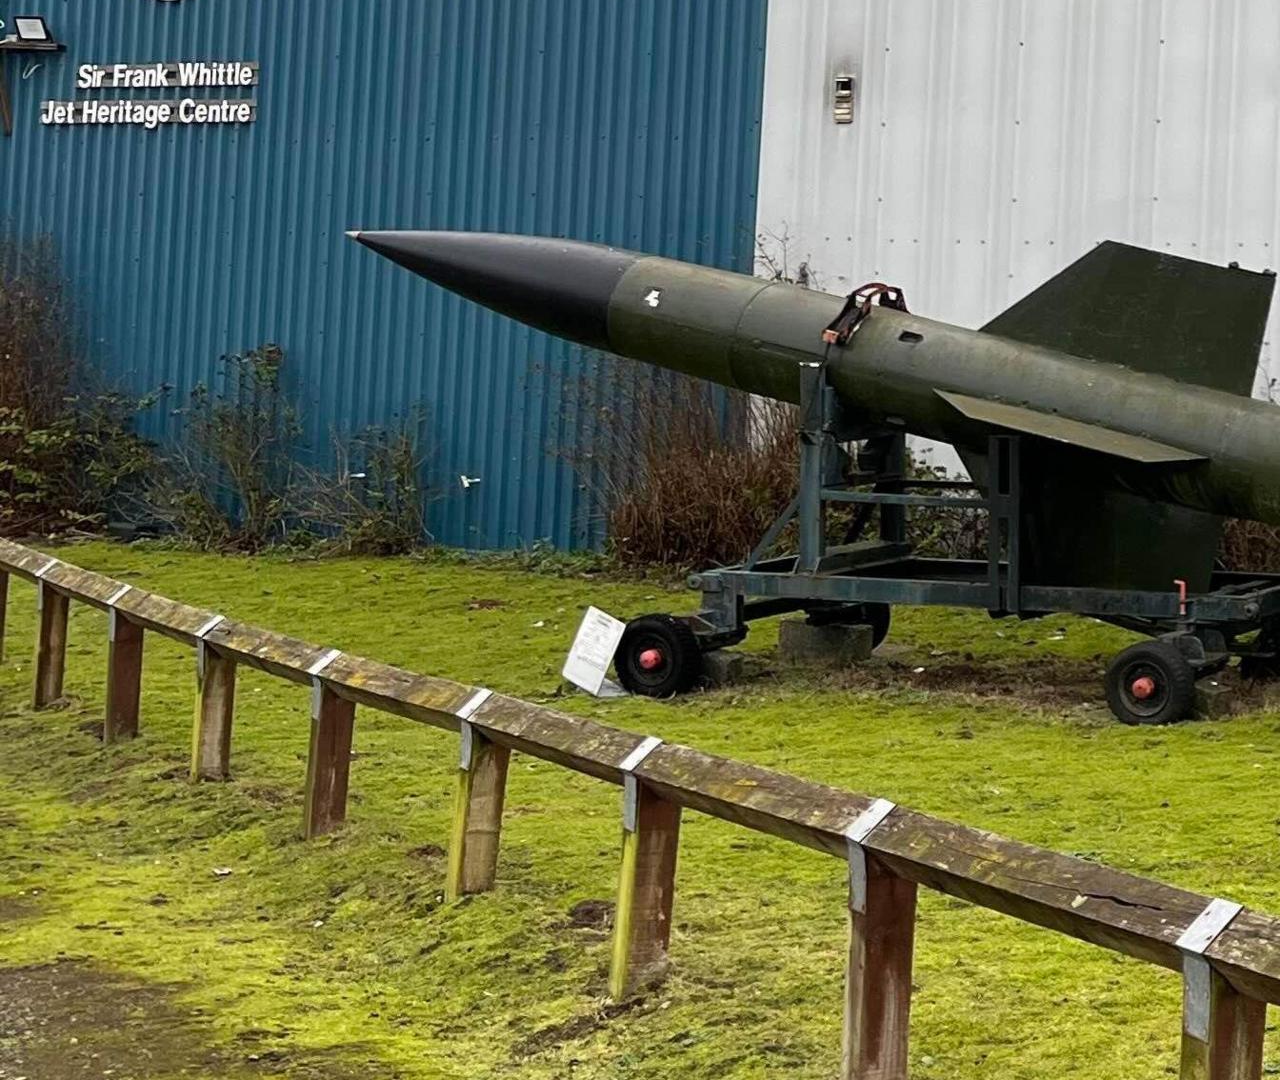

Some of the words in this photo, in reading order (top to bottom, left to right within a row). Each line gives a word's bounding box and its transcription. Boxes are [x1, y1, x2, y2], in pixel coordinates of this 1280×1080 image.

[78, 64, 104, 89] Sir
[112, 63, 168, 88] Frank
[178, 62, 253, 86] Whittle
[41, 100, 75, 124] Jet
[82, 99, 171, 129] Heritage
[179, 98, 250, 123] Centre
